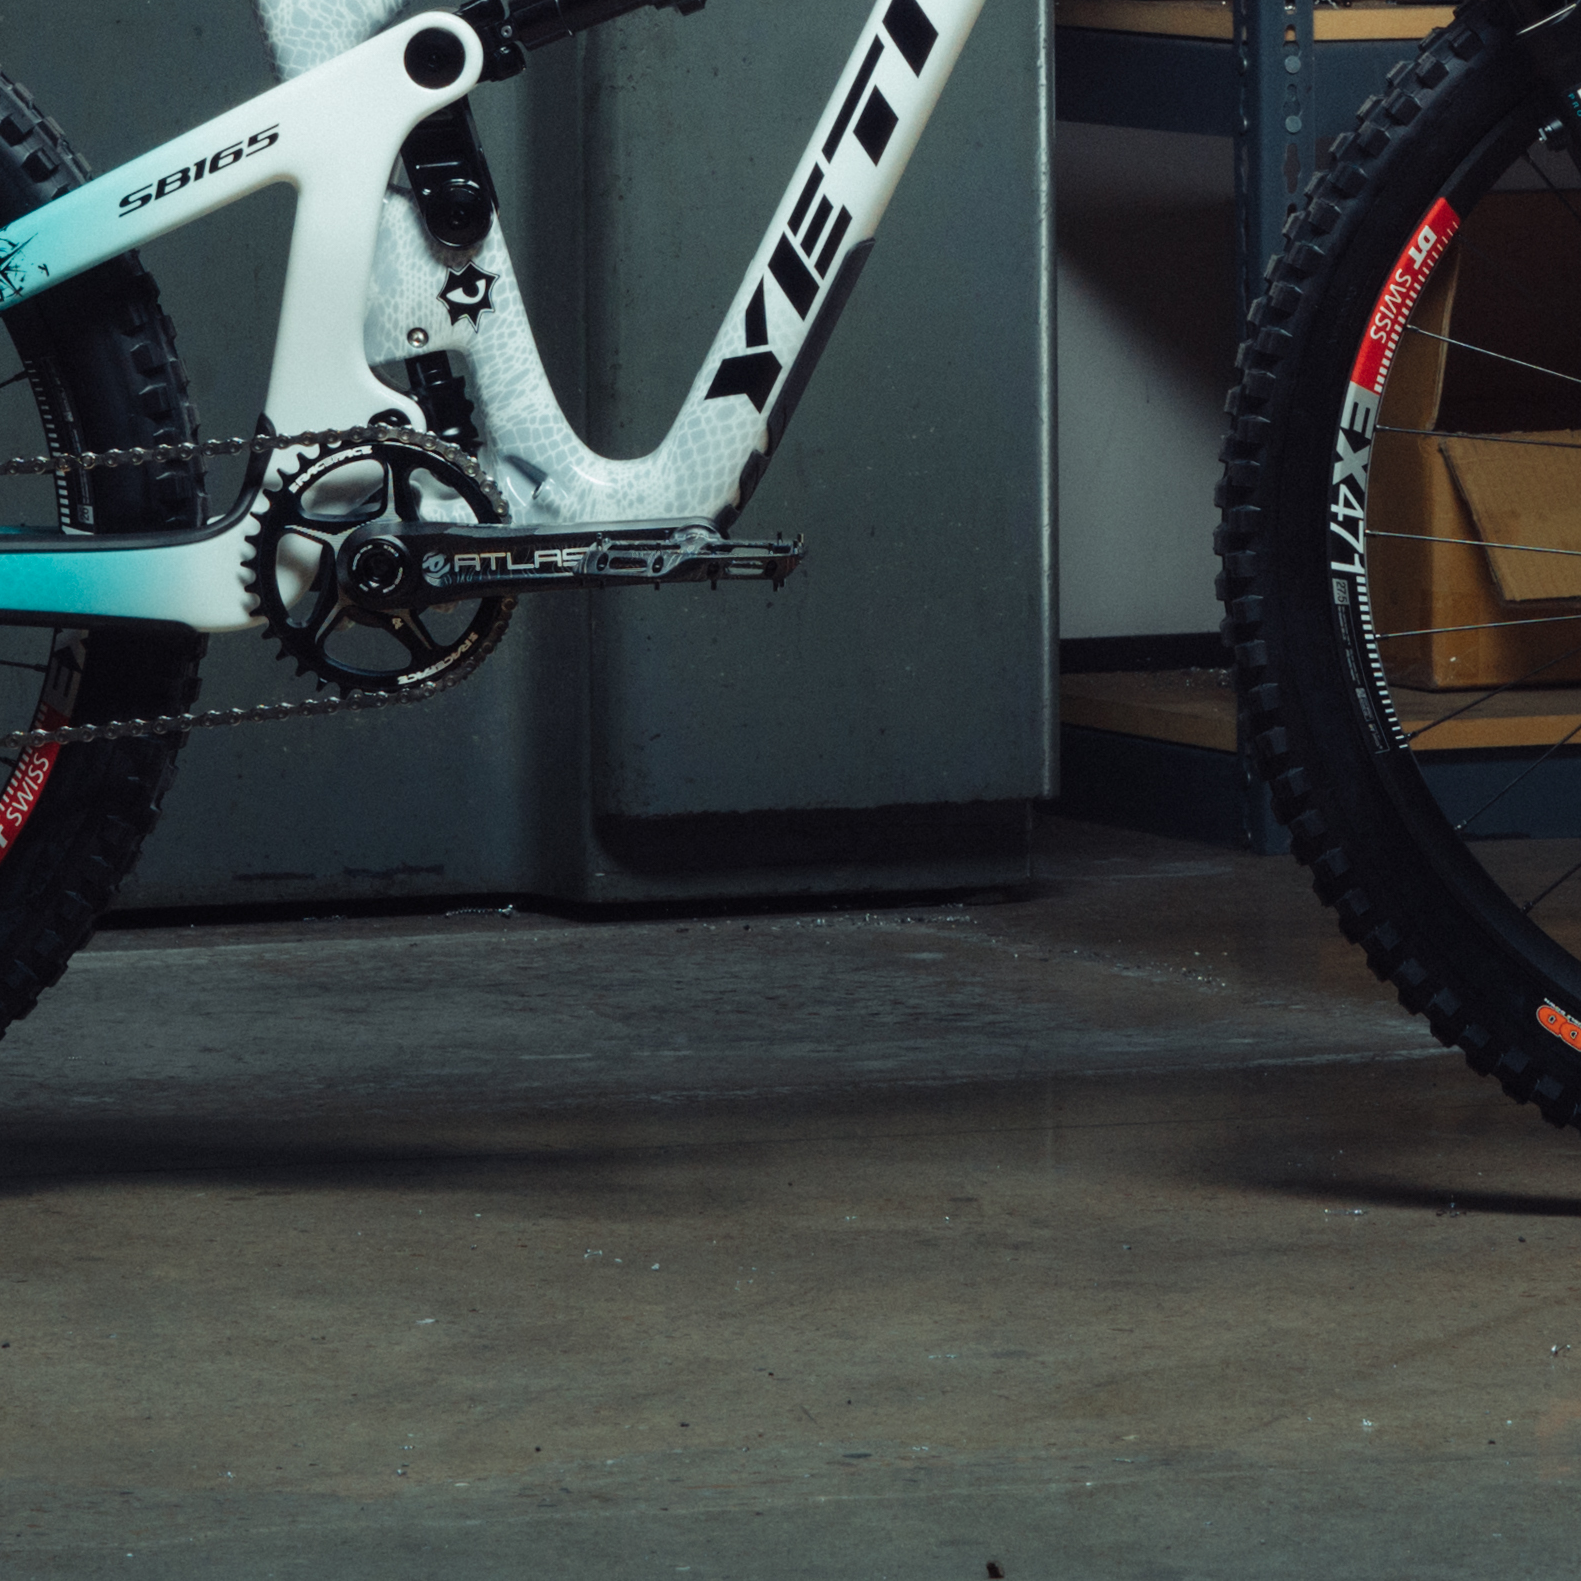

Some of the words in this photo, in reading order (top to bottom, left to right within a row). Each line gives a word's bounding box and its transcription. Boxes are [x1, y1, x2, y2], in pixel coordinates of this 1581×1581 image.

[118, 123, 281, 218] SB165
[1407, 224, 1438, 269] DT
[1369, 268, 1413, 346] SWISS
[1330, 395, 1377, 577] EX471
[454, 546, 590, 573] ATLAS
[1334, 579, 1348, 607] 27.5
[5, 752, 50, 828] SWISS
